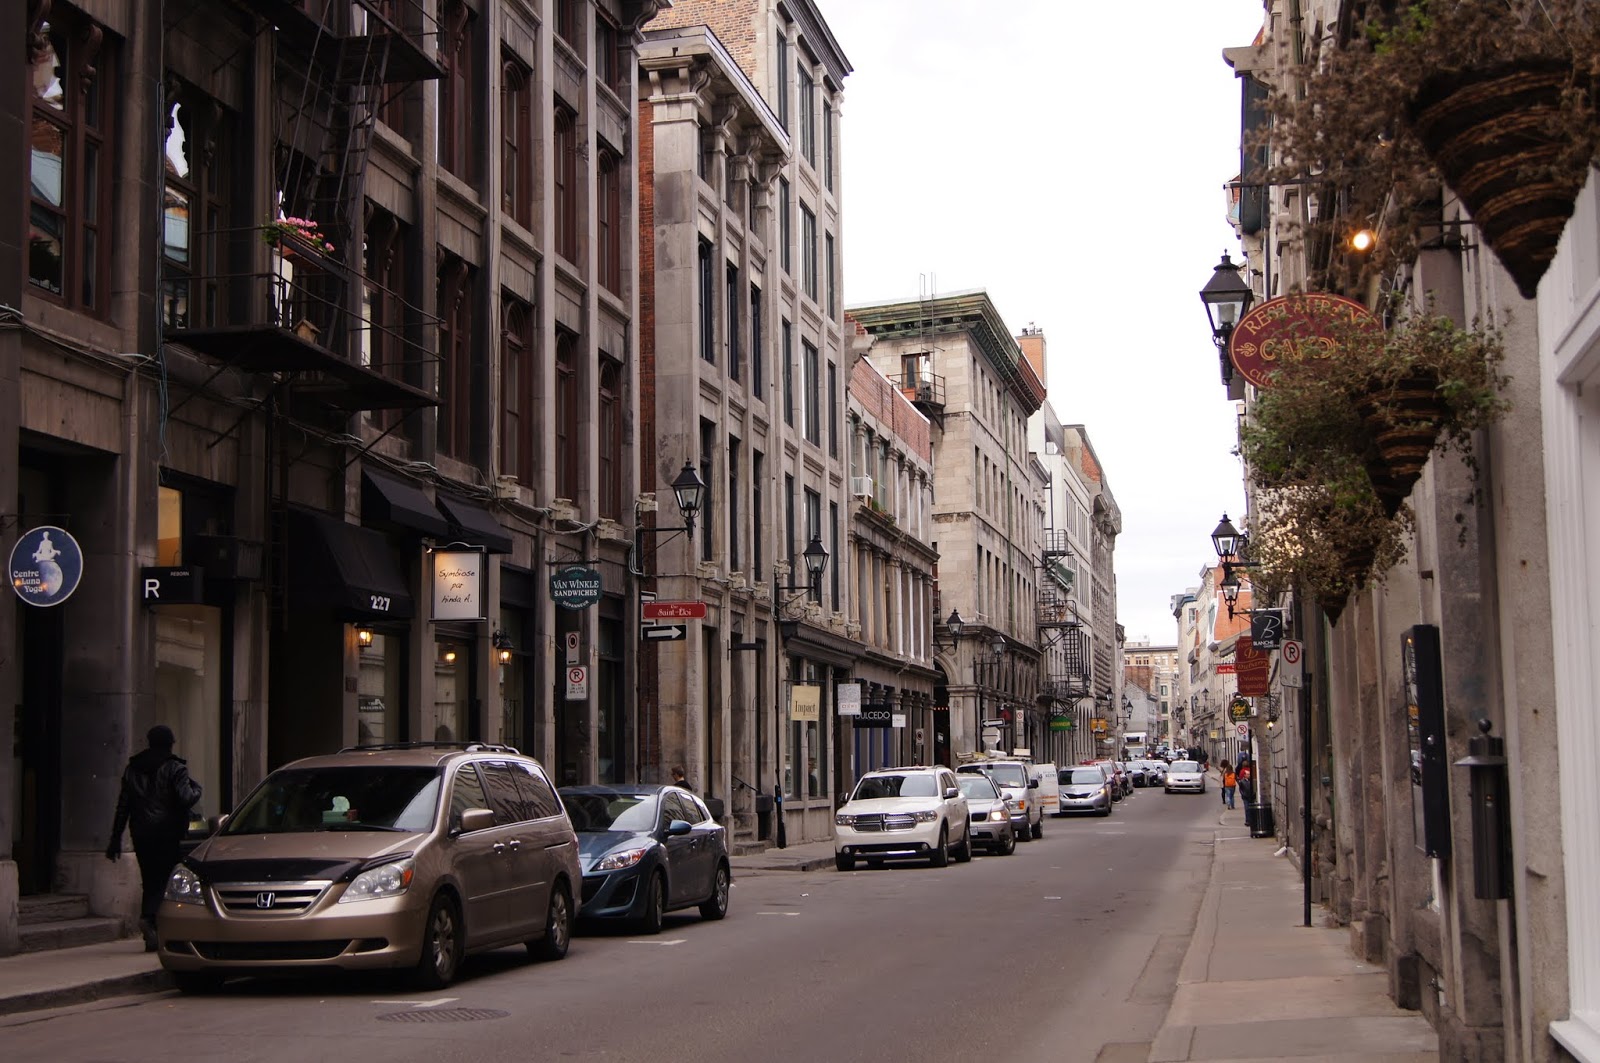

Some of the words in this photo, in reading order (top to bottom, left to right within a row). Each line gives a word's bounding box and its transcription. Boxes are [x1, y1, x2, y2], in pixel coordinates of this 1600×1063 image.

[13, 570, 39, 578] Centre
[438, 568, 476, 580] Symbiose
[144, 578, 160, 598] R
[450, 583, 464, 591] par
[553, 579, 568, 589] VAN
[569, 578, 600, 589] WINKLE
[24, 585, 43, 594] Yoga
[554, 589, 598, 597] SANDWICHES
[370, 594, 391, 612] 227
[794, 700, 816, 716] Impact
